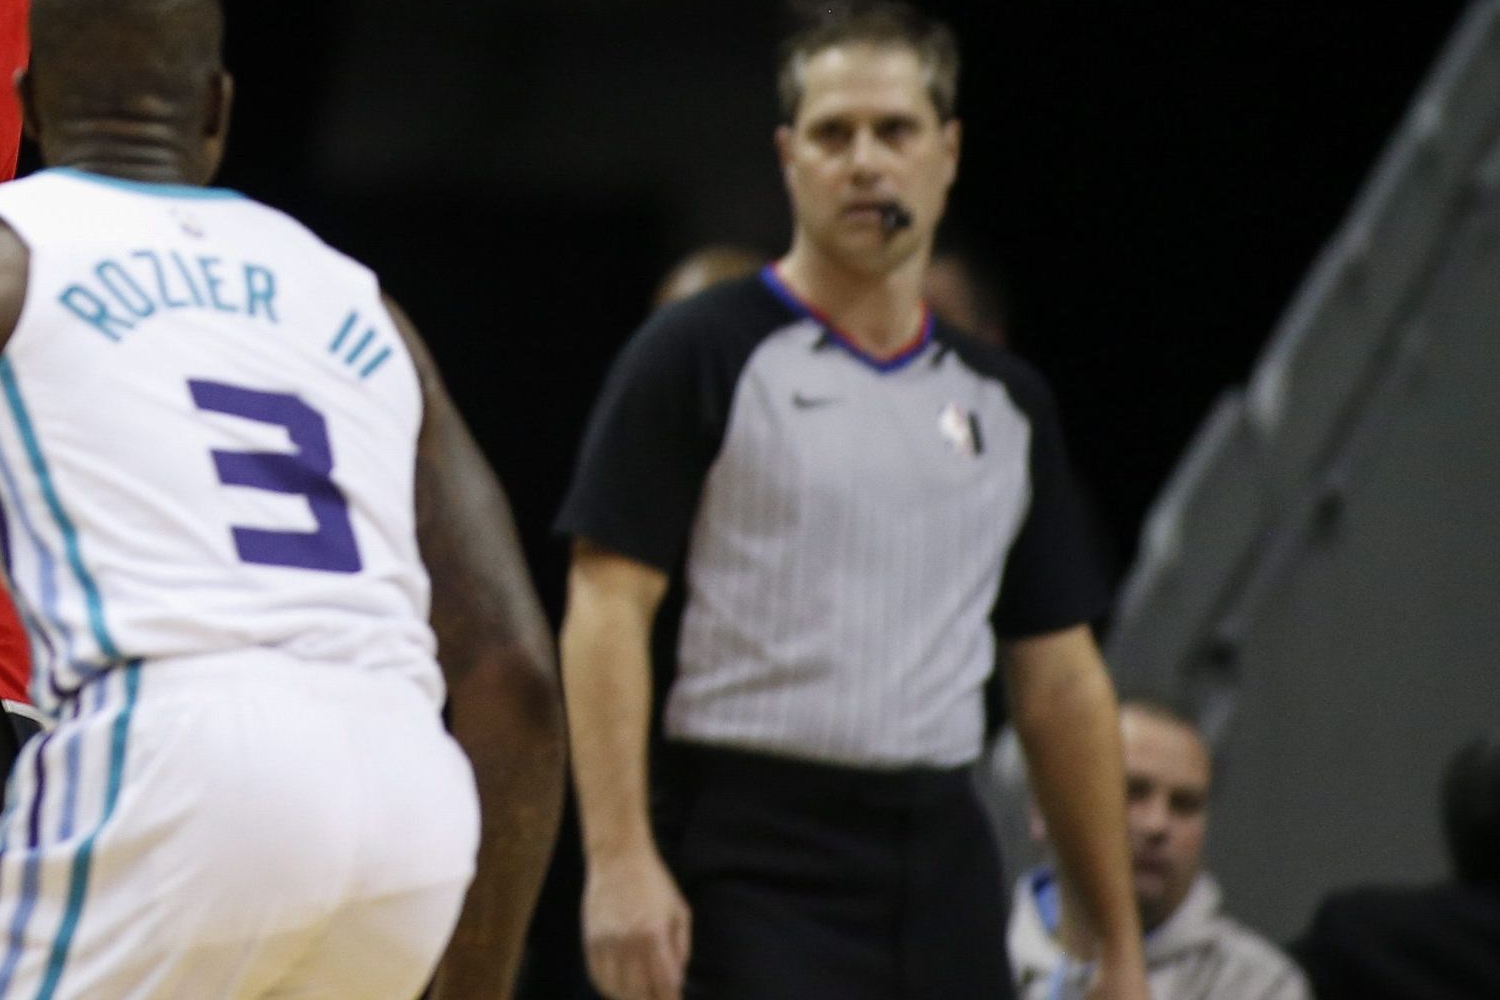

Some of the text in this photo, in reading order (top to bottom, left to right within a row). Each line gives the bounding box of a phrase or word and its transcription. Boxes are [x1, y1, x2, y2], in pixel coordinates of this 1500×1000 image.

[59, 249, 392, 378] ROZIER III
[186, 377, 363, 574] 3
